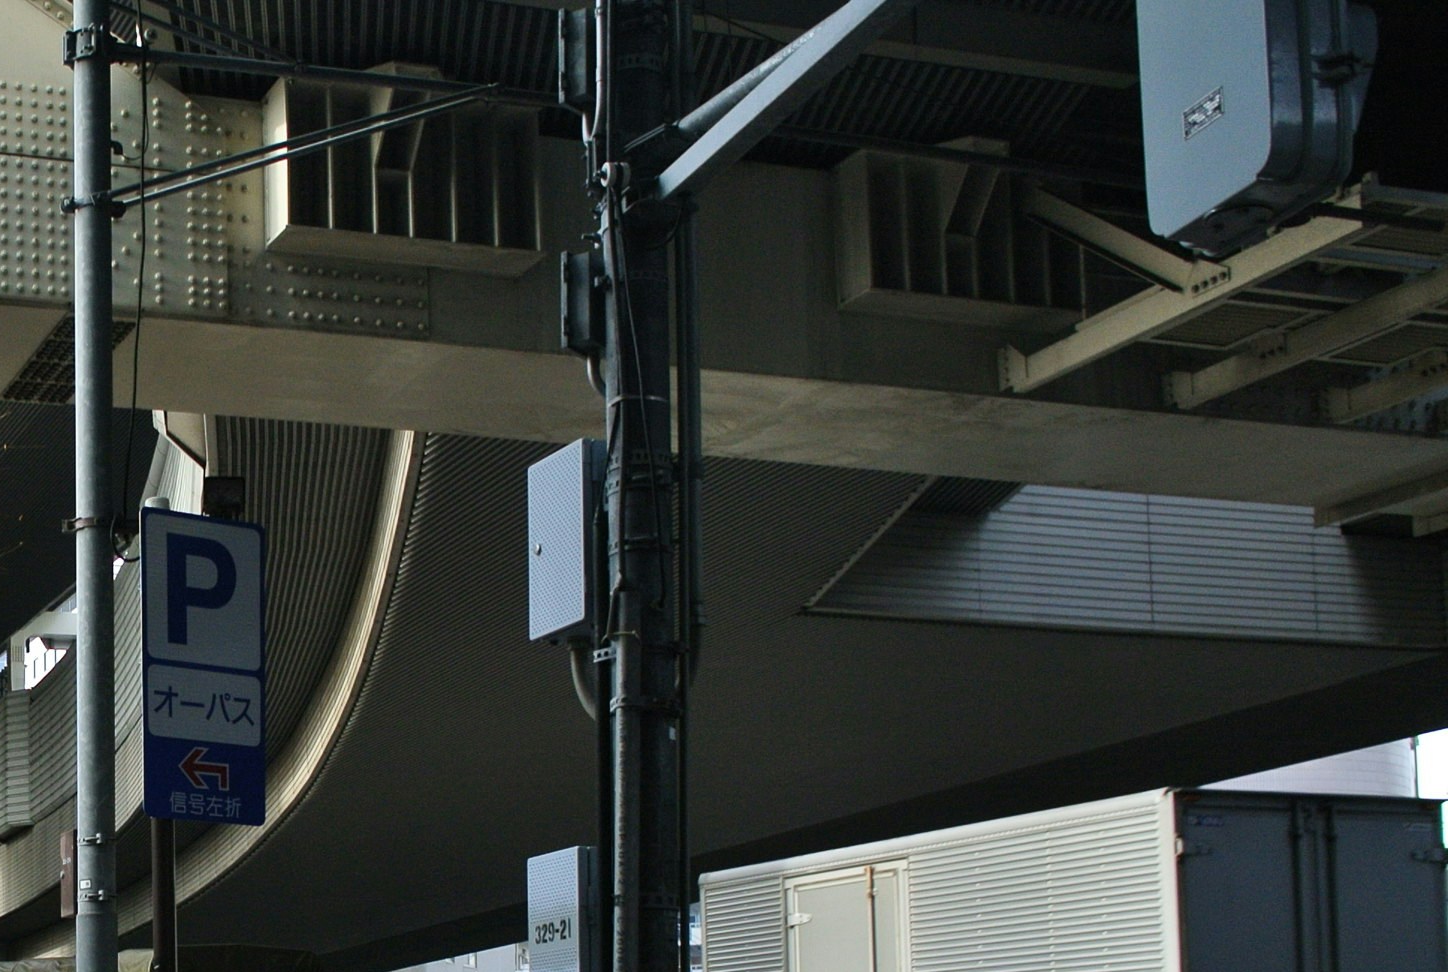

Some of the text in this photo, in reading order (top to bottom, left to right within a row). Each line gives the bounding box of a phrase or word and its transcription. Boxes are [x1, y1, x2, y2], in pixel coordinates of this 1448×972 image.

[165, 531, 238, 646] P
[153, 684, 255, 727] オーパス
[169, 791, 242, 819] 信号左折
[534, 917, 572, 945] 329-21
